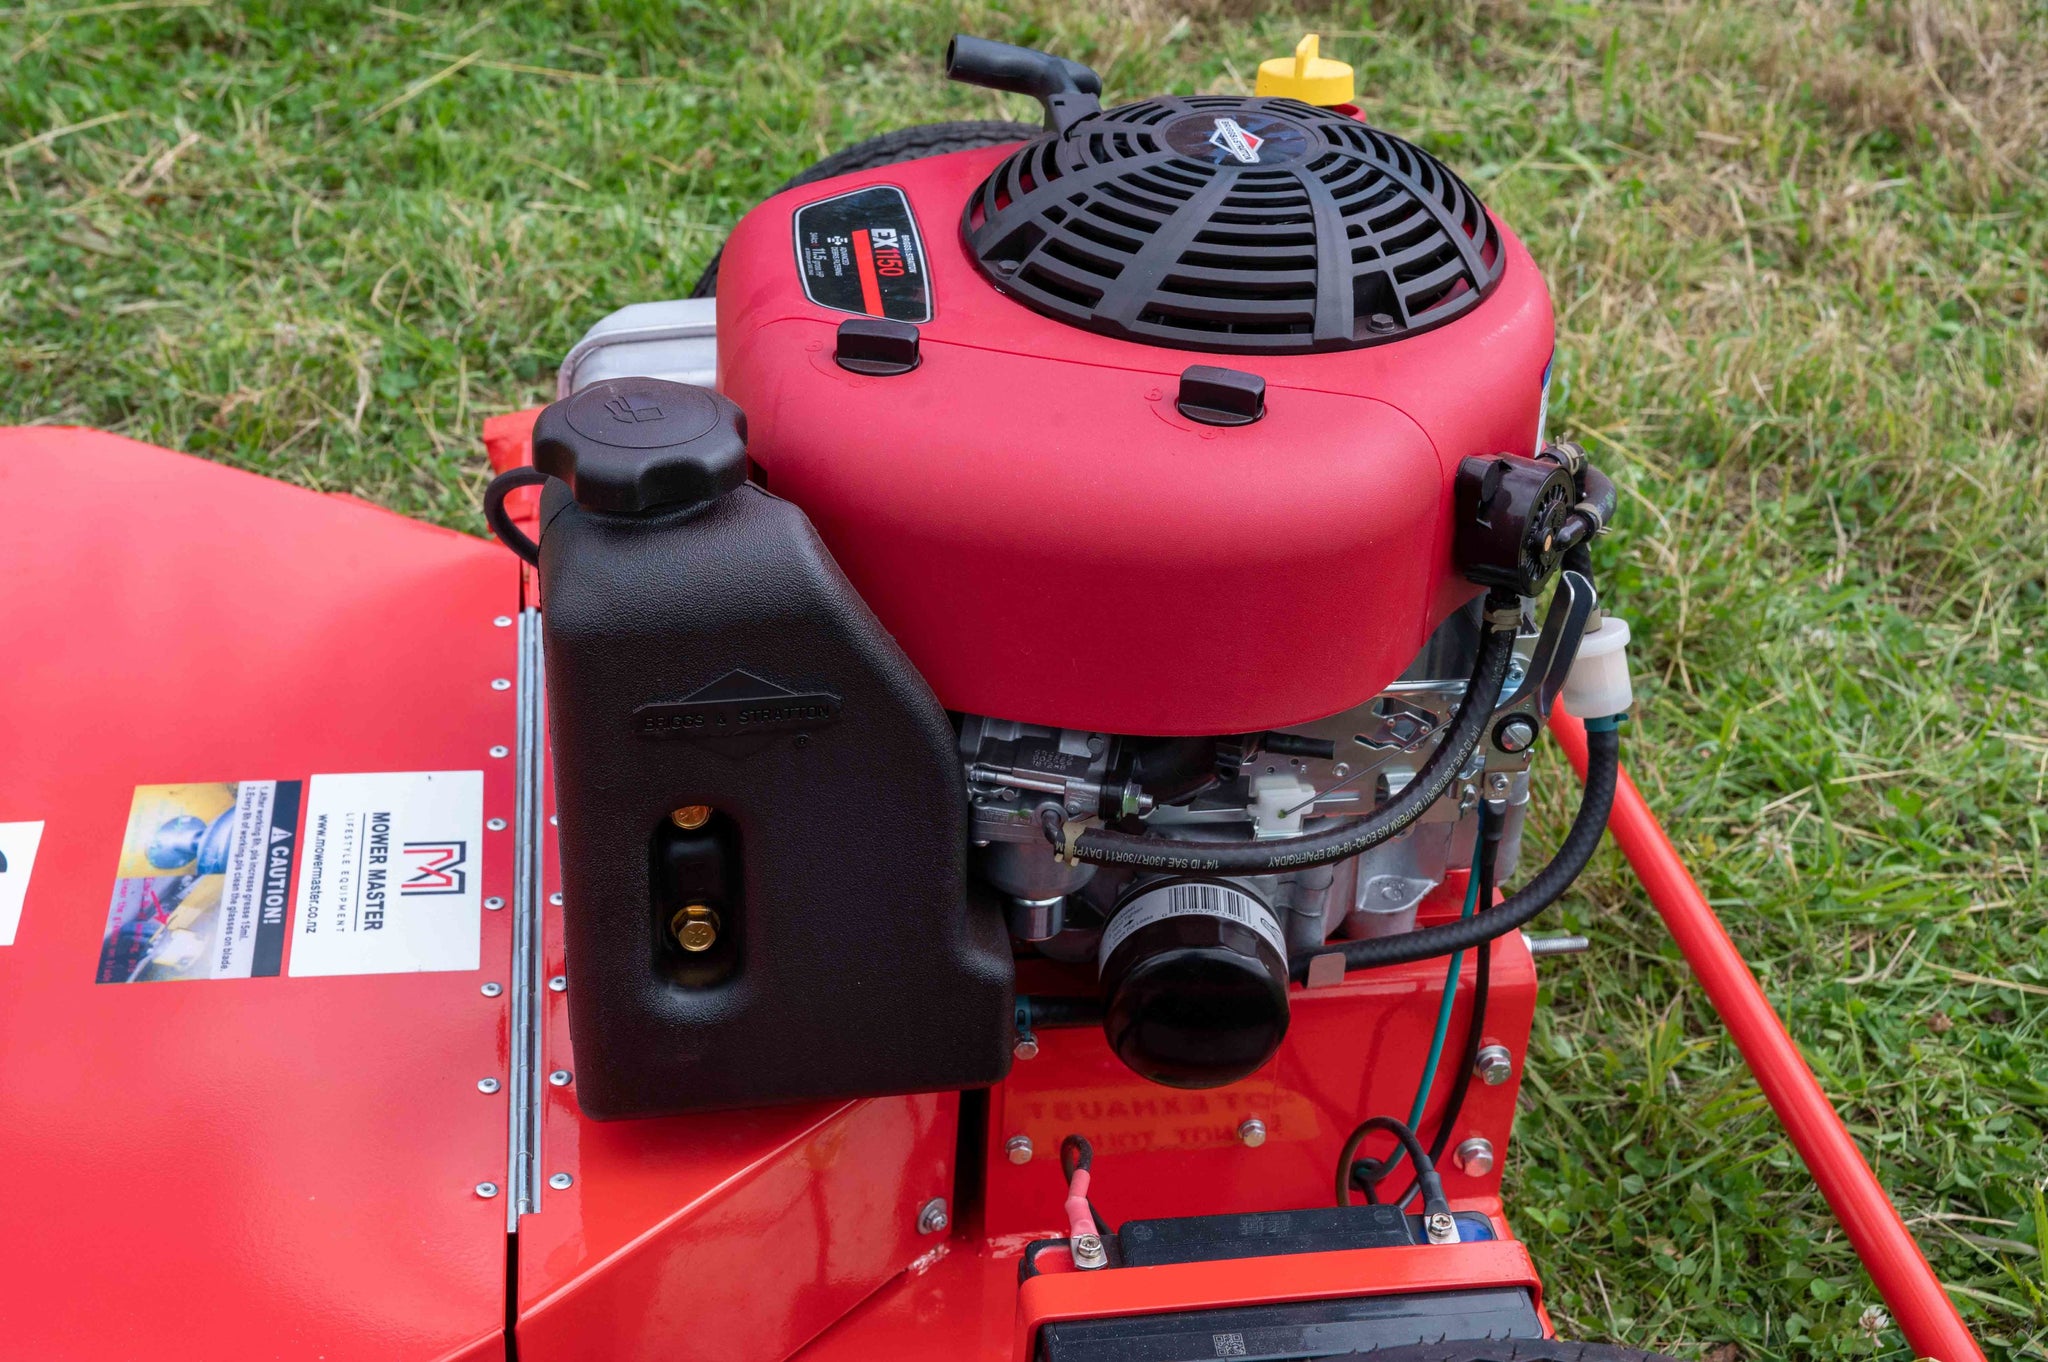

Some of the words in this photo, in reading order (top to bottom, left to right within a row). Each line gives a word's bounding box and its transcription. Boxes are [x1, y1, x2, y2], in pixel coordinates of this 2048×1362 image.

[811, 248, 827, 260] 11.5
[870, 228, 904, 276] EX1150
[644, 714, 704, 731] BRIGGS
[738, 705, 830, 725] STRATTON
[1463, 738, 1472, 751] ID
[1453, 749, 1468, 767] SAE
[241, 821, 250, 829] of
[251, 810, 264, 836] working
[1389, 801, 1423, 831] DAYPERM
[342, 812, 354, 864] LIFESTYLE
[369, 812, 391, 864] MOWER
[1106, 850, 1166, 866] J30R7/30R11
[1168, 857, 1188, 869] SAE
[1190, 859, 1200, 869] ID
[232, 872, 242, 891] clean
[246, 861, 258, 892] increase
[263, 846, 290, 924] CAUTION!
[306, 813, 329, 933] www.mowermaster.co.nz
[230, 893, 240, 904] the
[242, 894, 252, 918] grease
[336, 871, 350, 932] EQUIPMENT
[364, 869, 387, 931] MASTER
[225, 906, 238, 934] glasses
[224, 936, 232, 947] on
[220, 948, 232, 972] blade.
